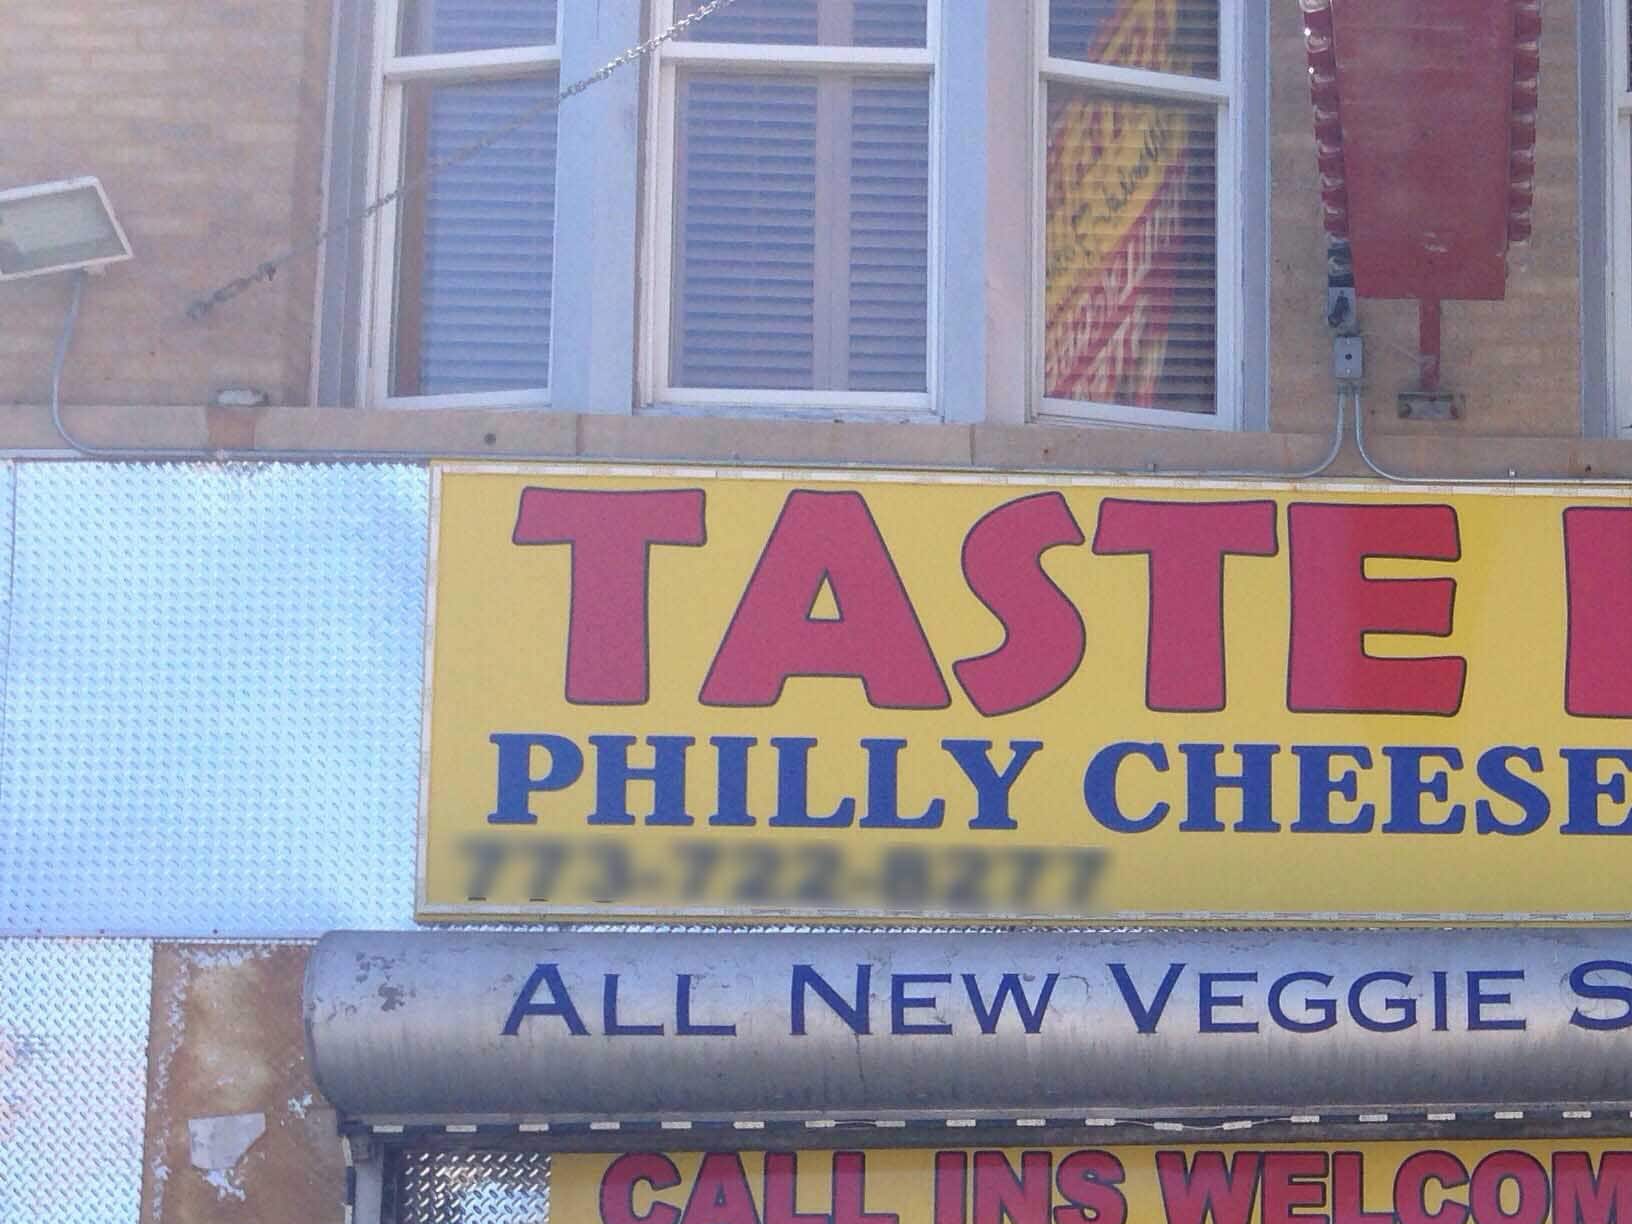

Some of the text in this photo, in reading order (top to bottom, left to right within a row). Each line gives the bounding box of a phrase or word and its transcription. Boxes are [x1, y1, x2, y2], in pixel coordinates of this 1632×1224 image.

[511, 486, 1467, 717] TASTE
[487, 733, 1043, 831] PHILLY
[501, 962, 736, 1036] ALL
[789, 963, 1060, 1036] NEW
[1106, 960, 1527, 1036] VEGGIE
